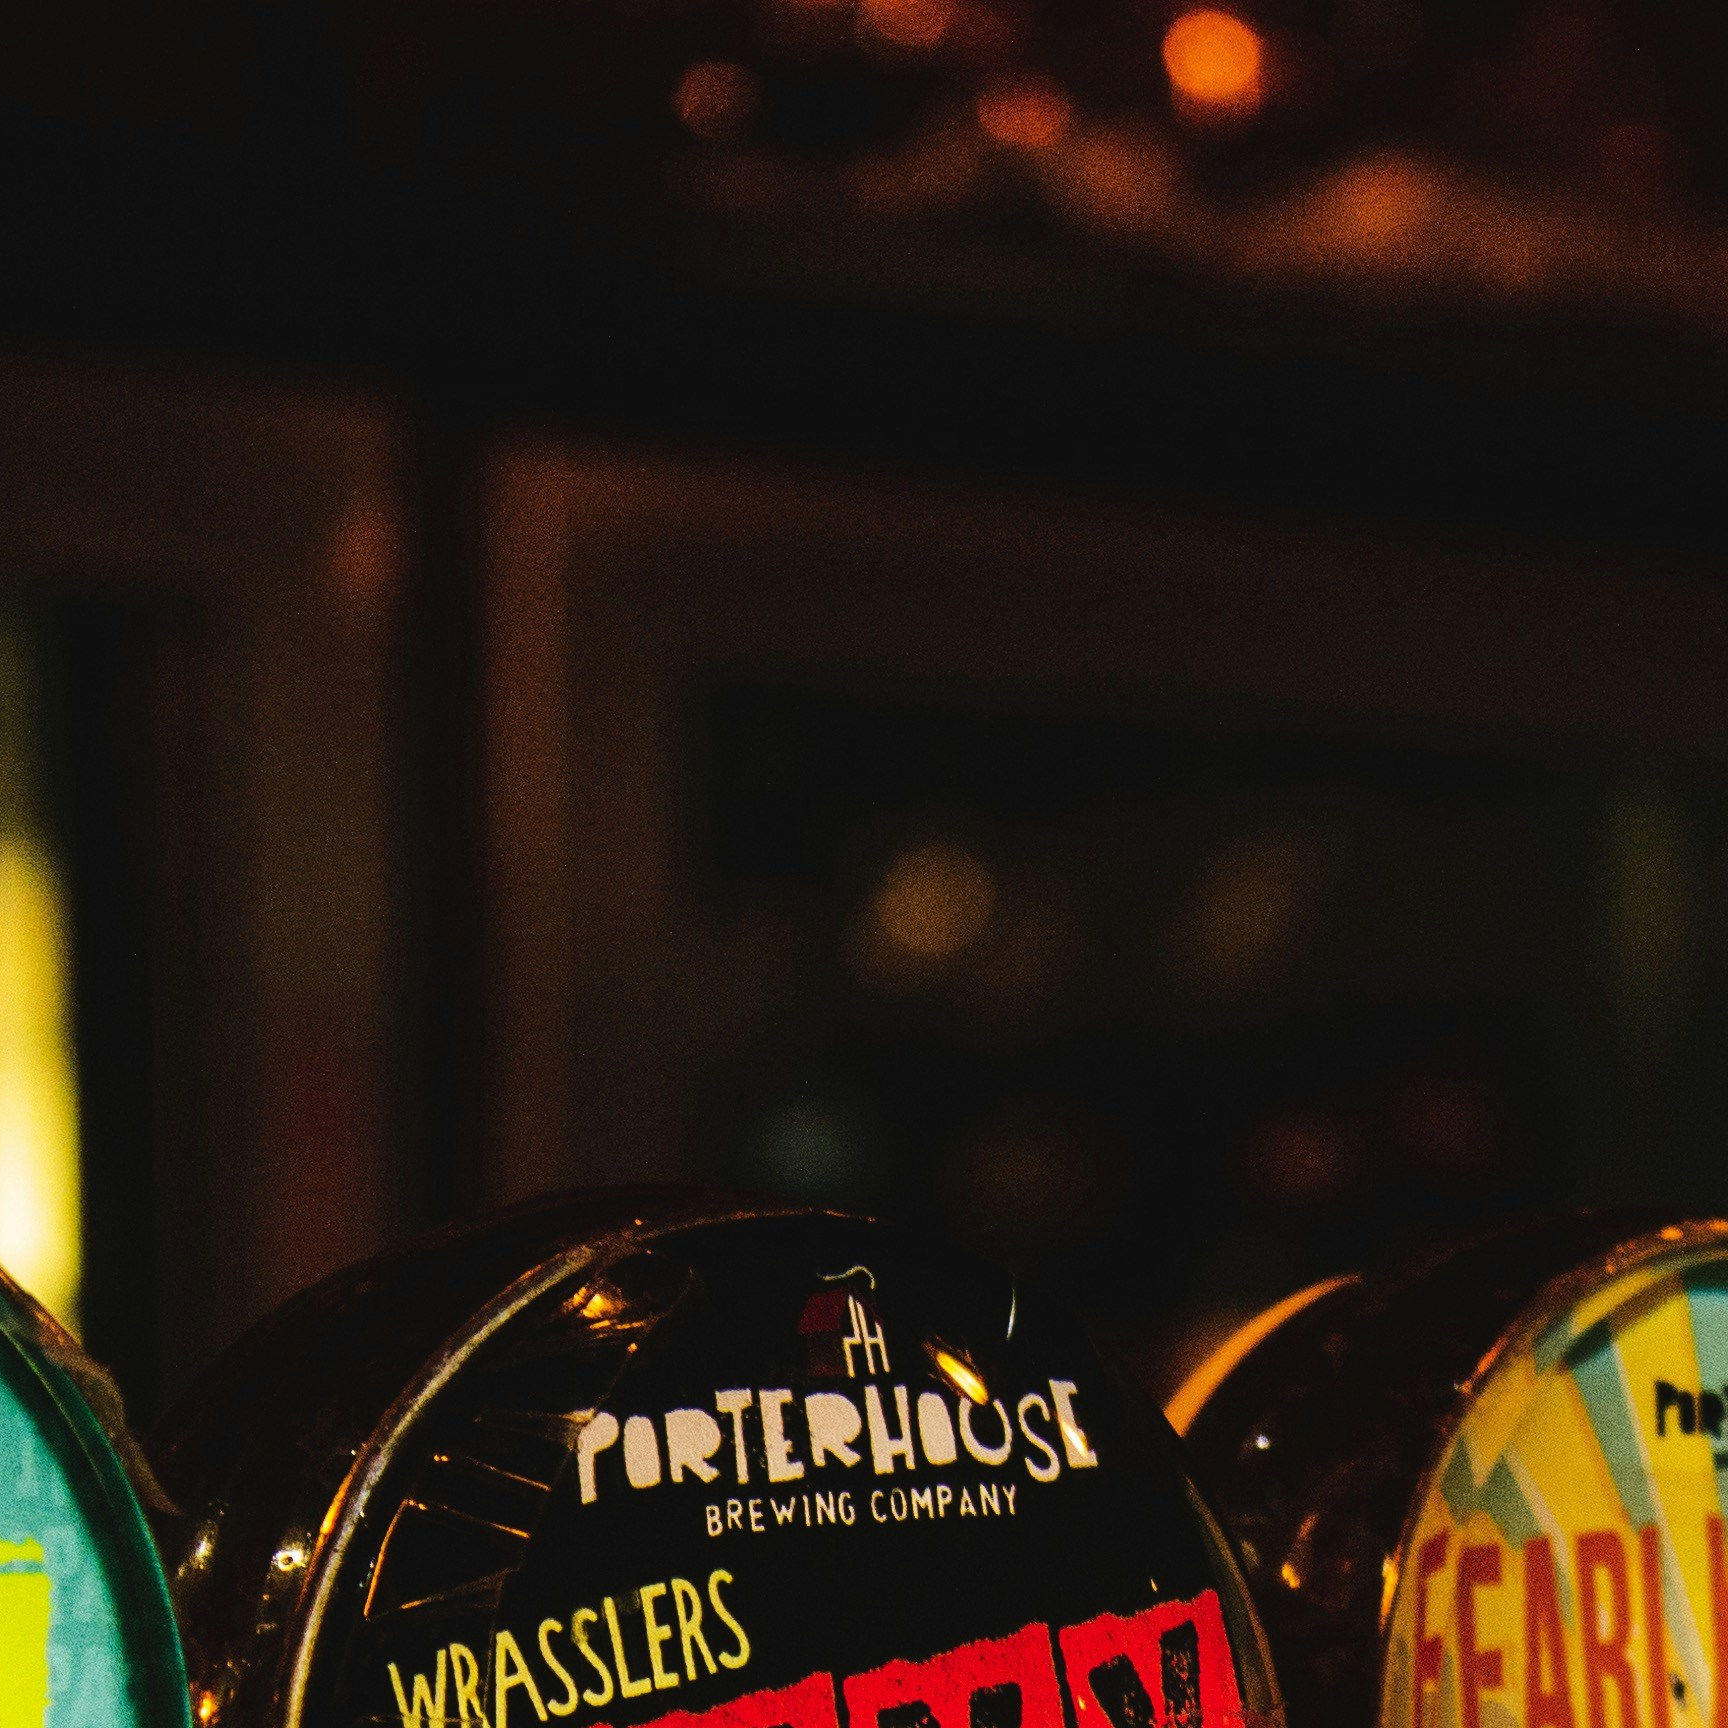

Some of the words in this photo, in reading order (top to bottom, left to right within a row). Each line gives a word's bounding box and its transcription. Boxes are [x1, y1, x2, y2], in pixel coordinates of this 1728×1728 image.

[575, 1378, 1099, 1505] PORTERHOUSE
[705, 1492, 858, 1538] BREWING
[870, 1483, 1018, 1524] COMPANY
